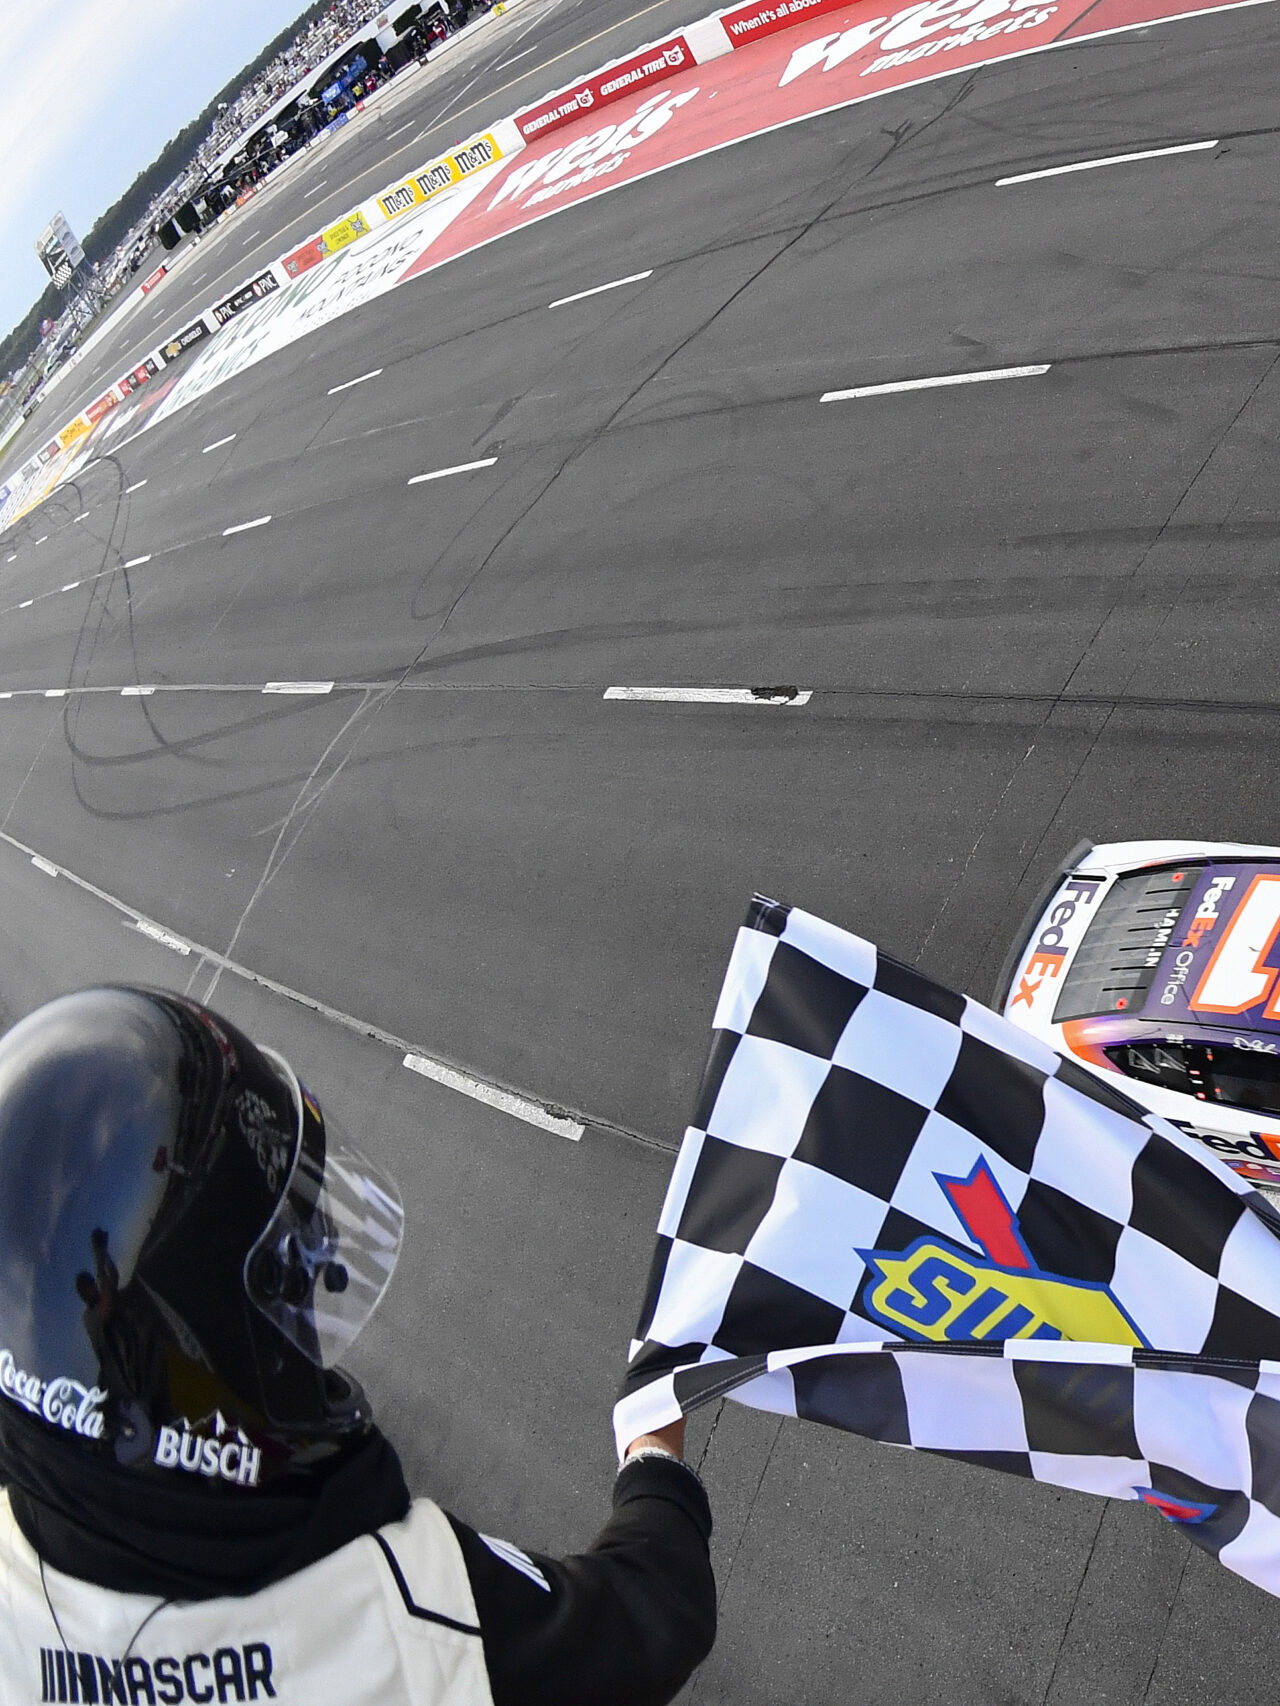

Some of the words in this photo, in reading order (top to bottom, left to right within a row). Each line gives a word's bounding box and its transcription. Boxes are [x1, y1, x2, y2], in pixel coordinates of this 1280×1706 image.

[729, 16, 761, 36] When
[758, 10, 777, 25] it's
[775, 2, 790, 18] all
[858, 6, 1059, 78] markets
[600, 68, 645, 97] GENERAL
[641, 56, 668, 77] TIRE
[522, 110, 562, 136] GENERAL
[557, 98, 580, 119] TIRE
[219, 302, 236, 321] PNC
[259, 274, 278, 294] PNC
[1143, 908, 1181, 968] HAMLIN
[1182, 876, 1237, 948] FedEx
[1011, 879, 1102, 1010] FedEx
[1160, 951, 1195, 1006] Office
[0, 1350, 109, 1440] Coca-Cola
[153, 1423, 262, 1488] BUSCH
[95, 1641, 277, 1706] NASCAR
